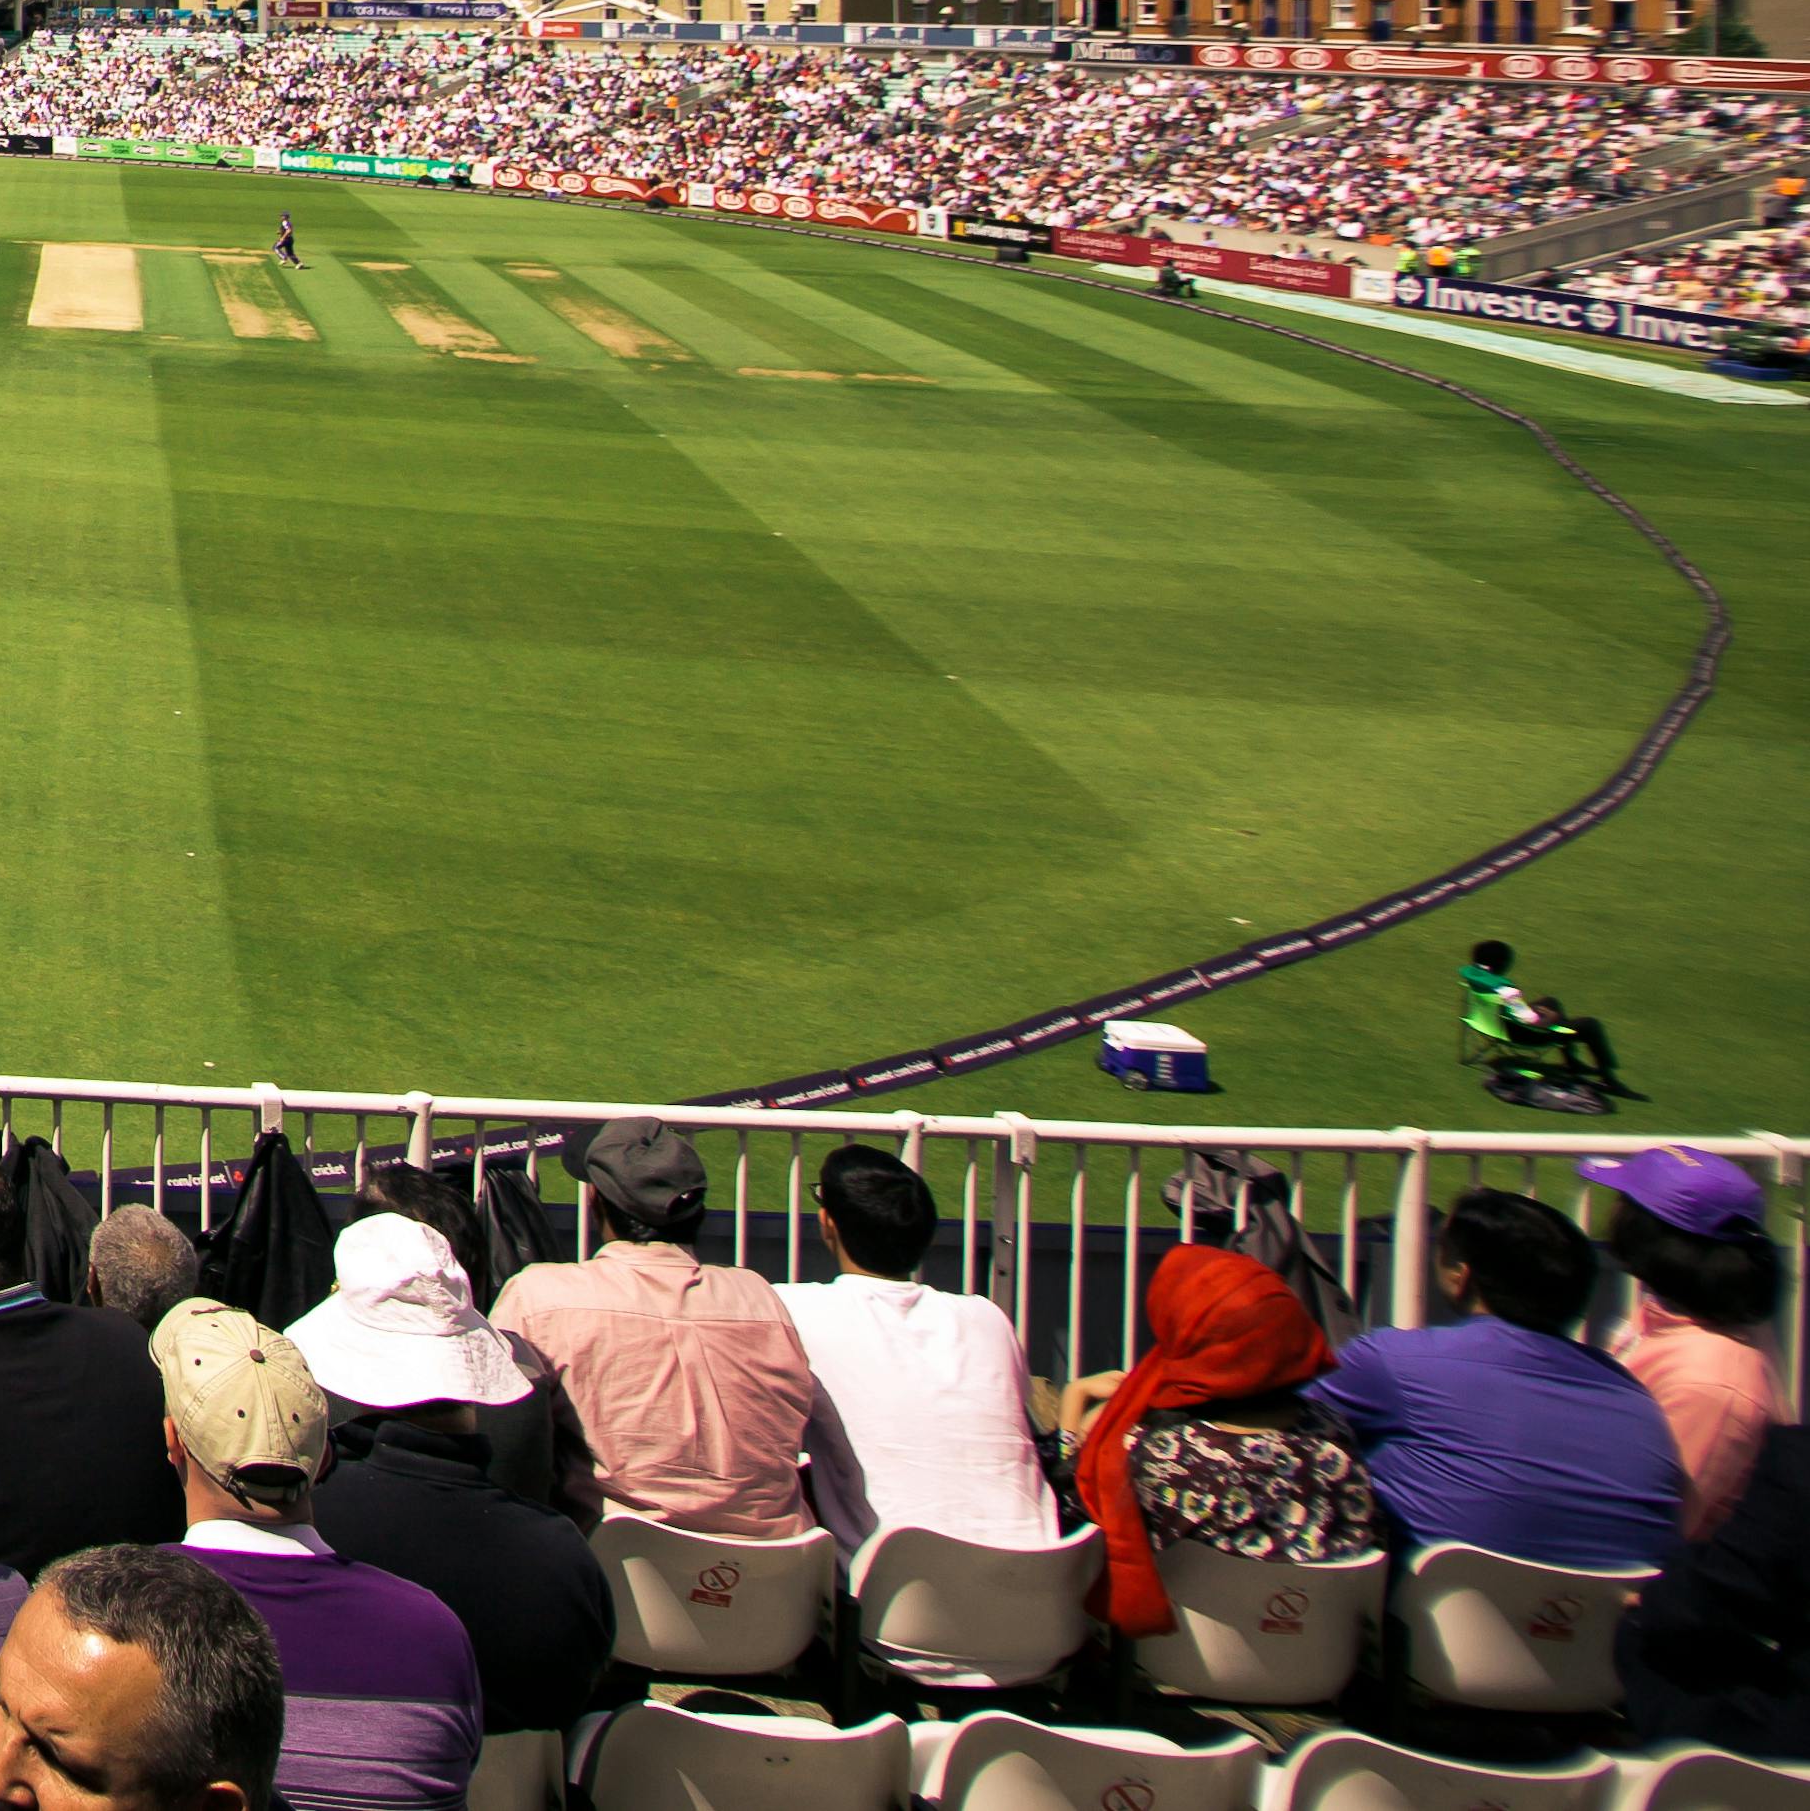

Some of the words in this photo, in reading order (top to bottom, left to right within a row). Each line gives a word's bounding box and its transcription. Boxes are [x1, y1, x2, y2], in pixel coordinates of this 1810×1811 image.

[281, 152, 369, 173] bet365.com
[374, 159, 455, 179] bet365.co
[1424, 277, 1582, 327] Investec
